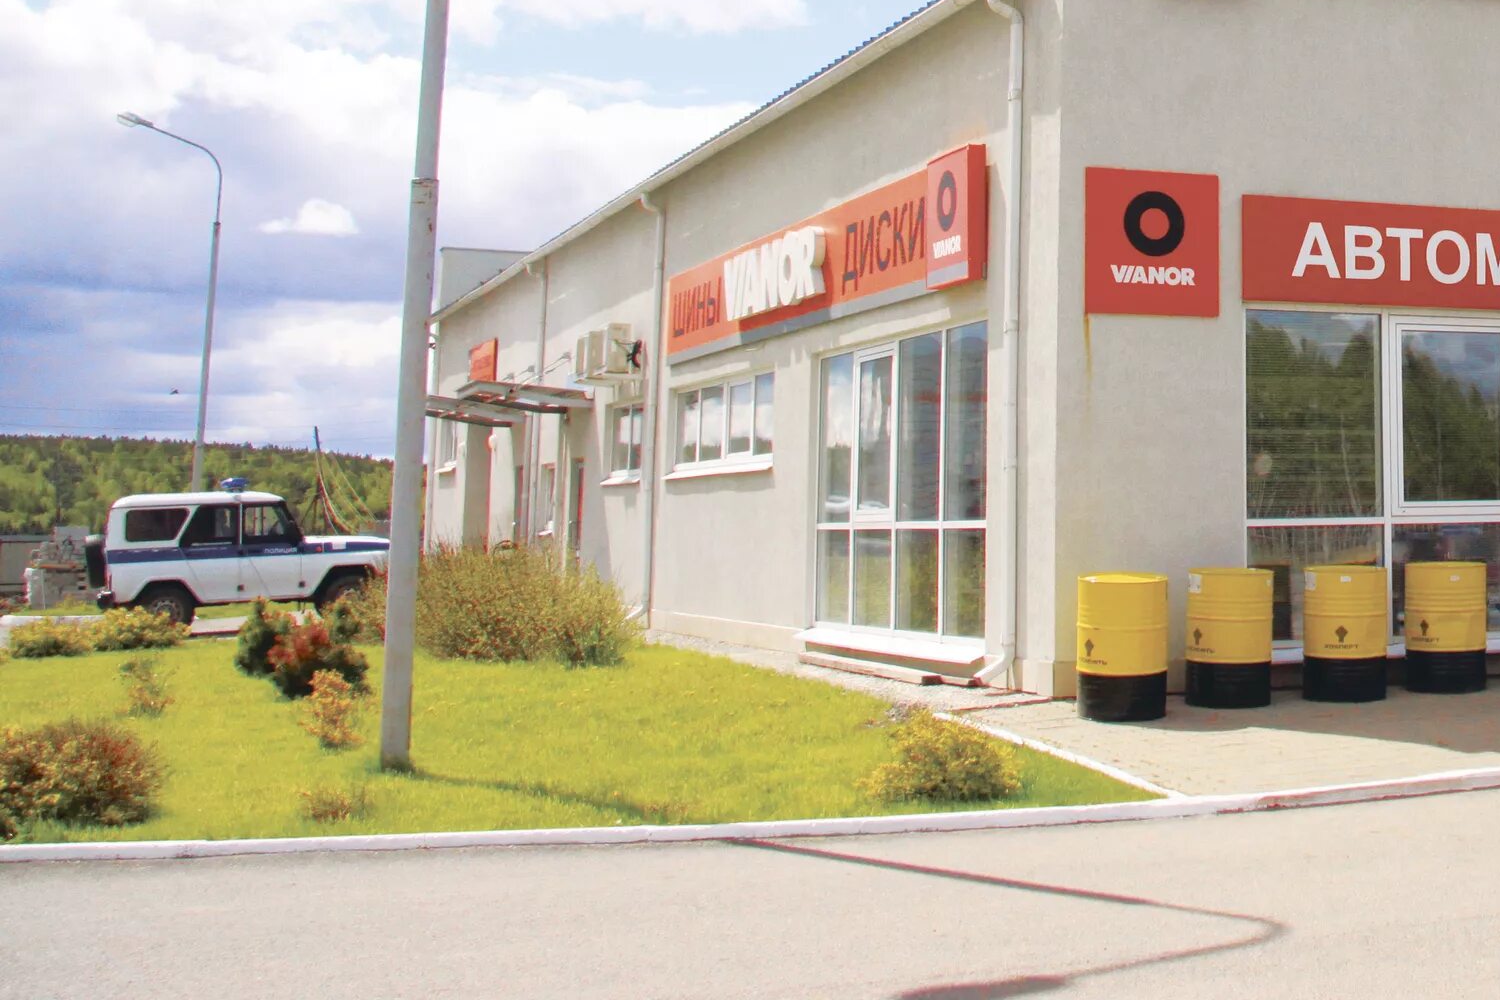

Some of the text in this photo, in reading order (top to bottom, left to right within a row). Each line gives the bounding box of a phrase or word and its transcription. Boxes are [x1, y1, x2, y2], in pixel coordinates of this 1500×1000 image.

[933, 235, 961, 260] VIANOR
[672, 196, 926, 338] ШИНЫ VIANOR ДИСКИ
[1110, 264, 1195, 286] VIANOR
